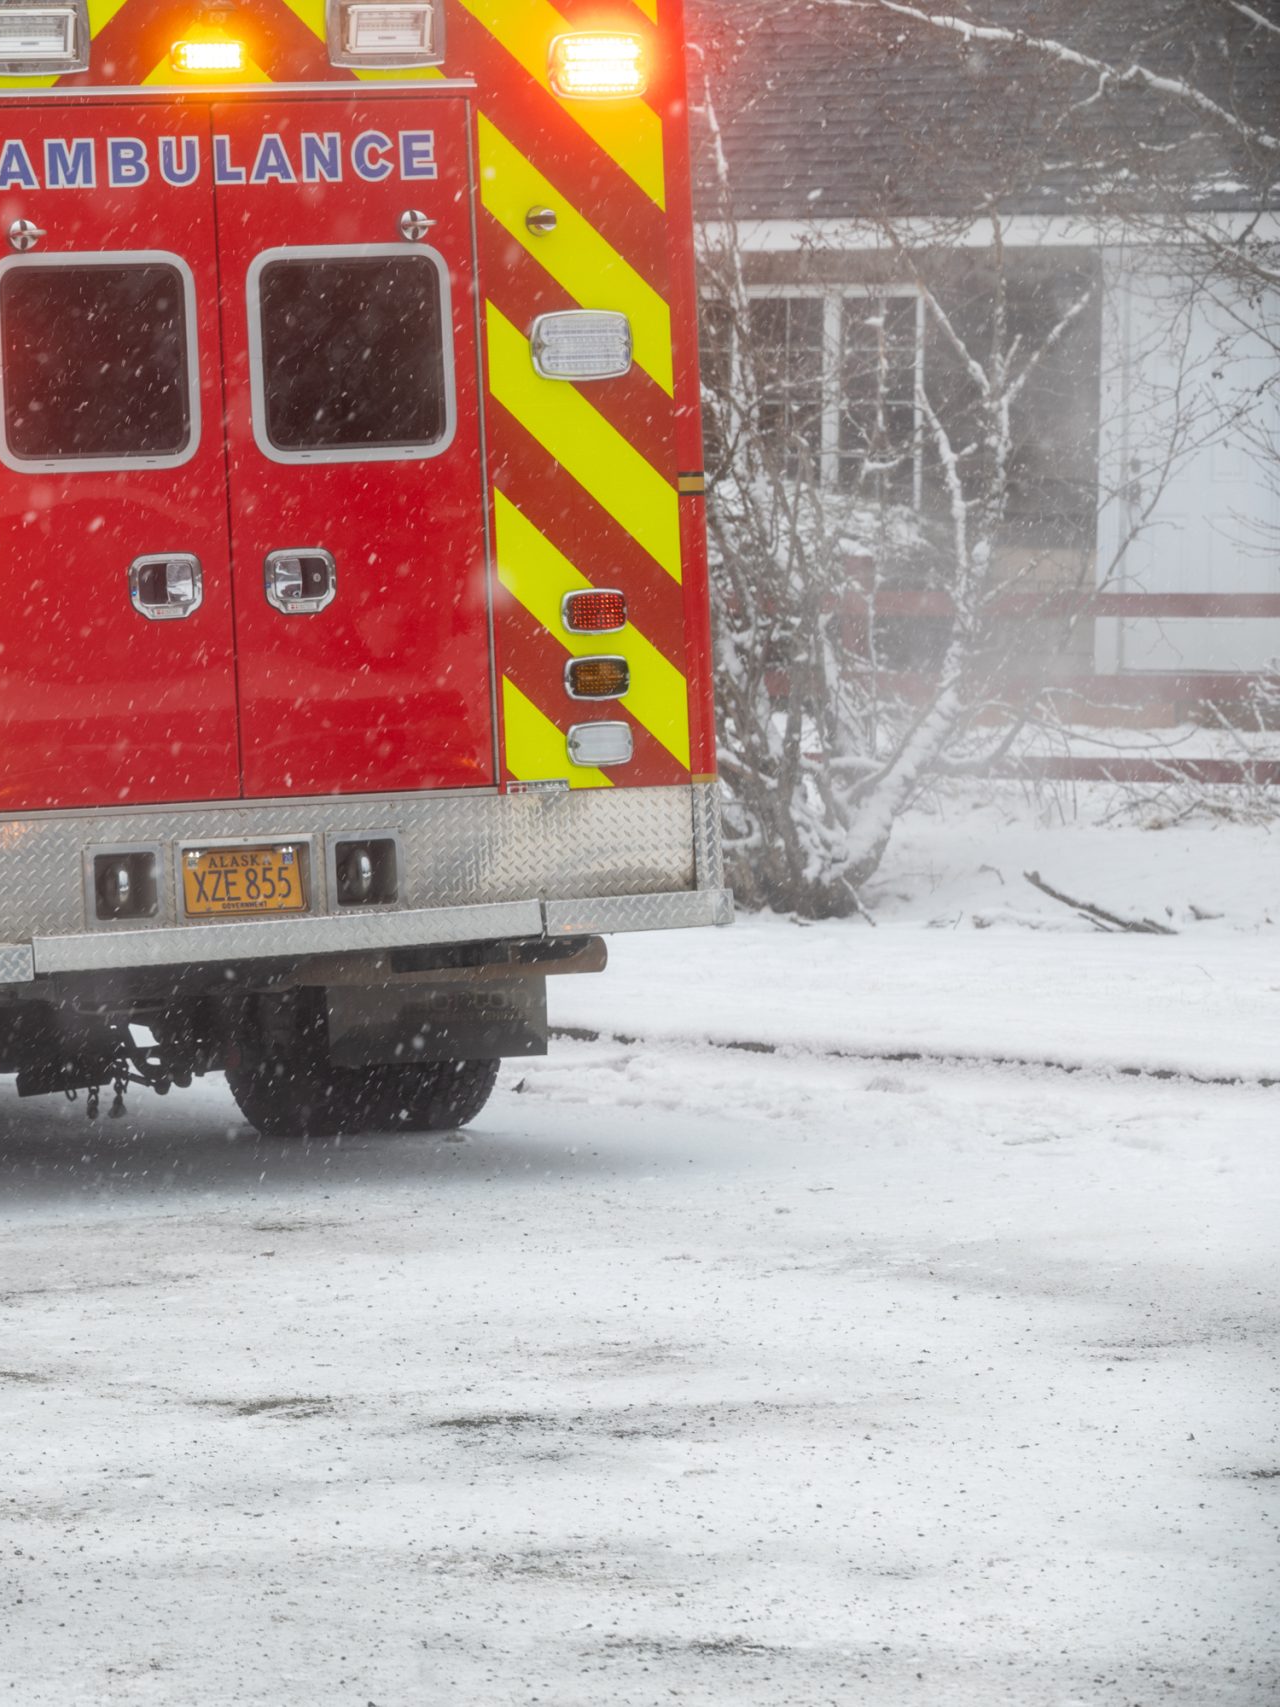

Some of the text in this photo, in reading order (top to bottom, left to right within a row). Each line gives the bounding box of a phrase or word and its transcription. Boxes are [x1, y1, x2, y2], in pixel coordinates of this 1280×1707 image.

[208, 854, 272, 869] ALASKA
[193, 866, 292, 902] XZE 855
